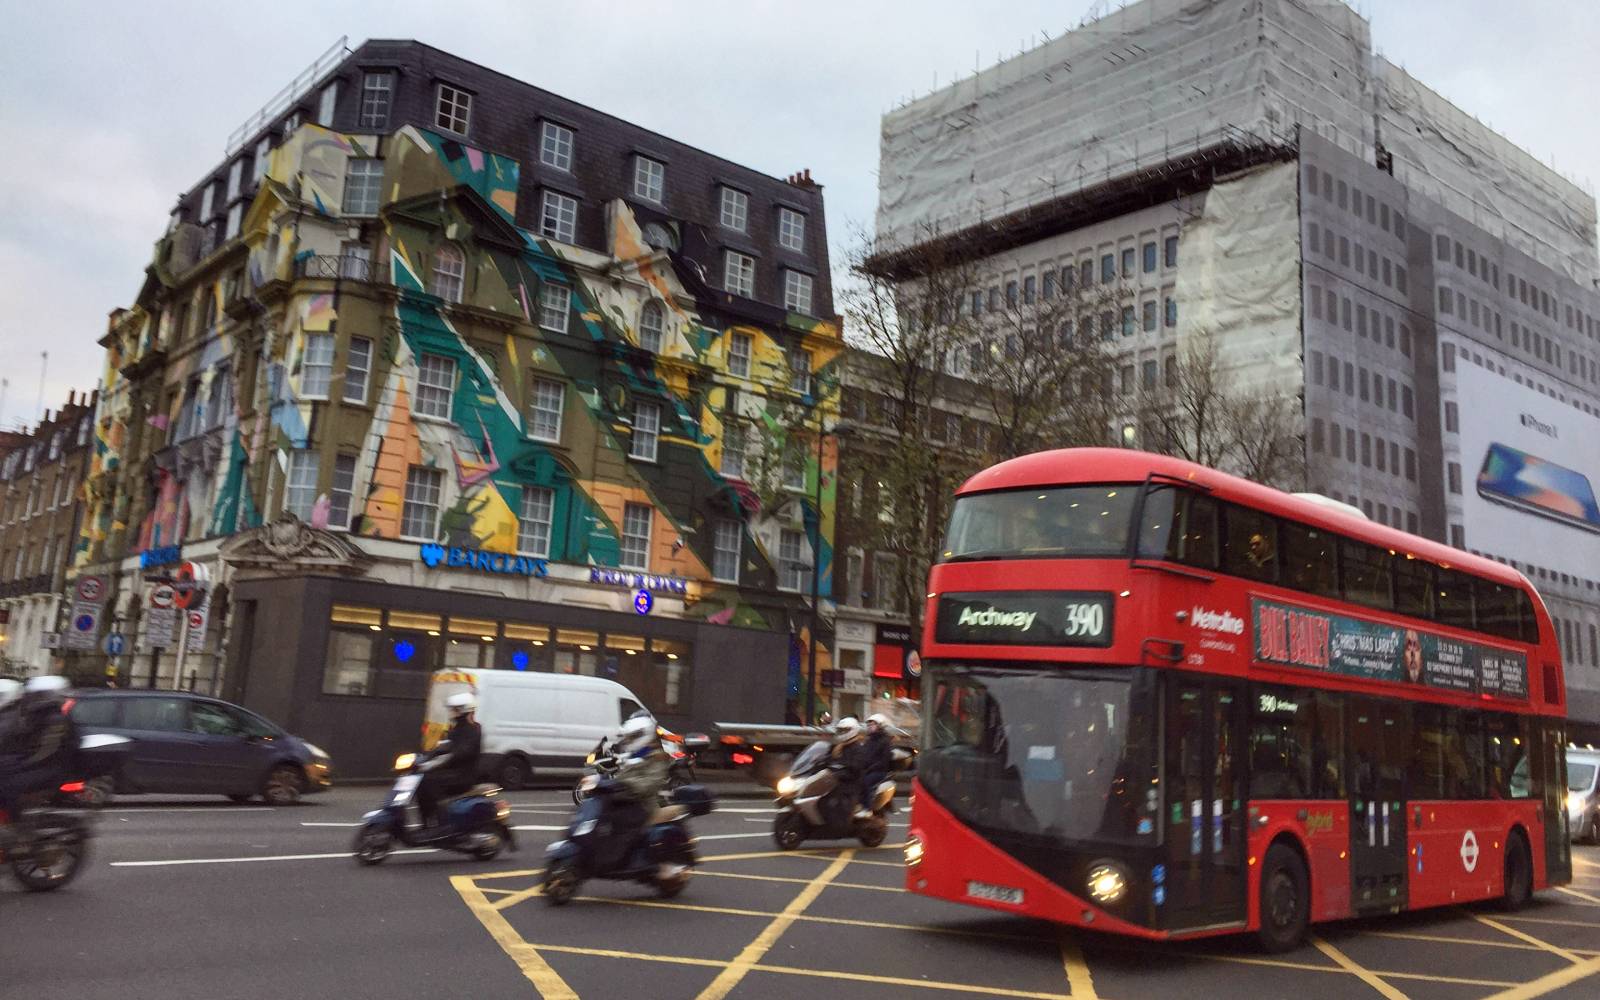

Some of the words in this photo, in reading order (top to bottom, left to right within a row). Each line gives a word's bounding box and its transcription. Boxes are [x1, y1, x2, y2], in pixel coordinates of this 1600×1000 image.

[447, 547, 550, 578] BARCLAYS
[958, 606, 1037, 632] Archway
[1065, 603, 1104, 637] 390
[1191, 605, 1244, 635] Metroline
[1259, 605, 1288, 662] BILL
[1288, 610, 1330, 669] BAILEY
[1259, 694, 1276, 713] 390
